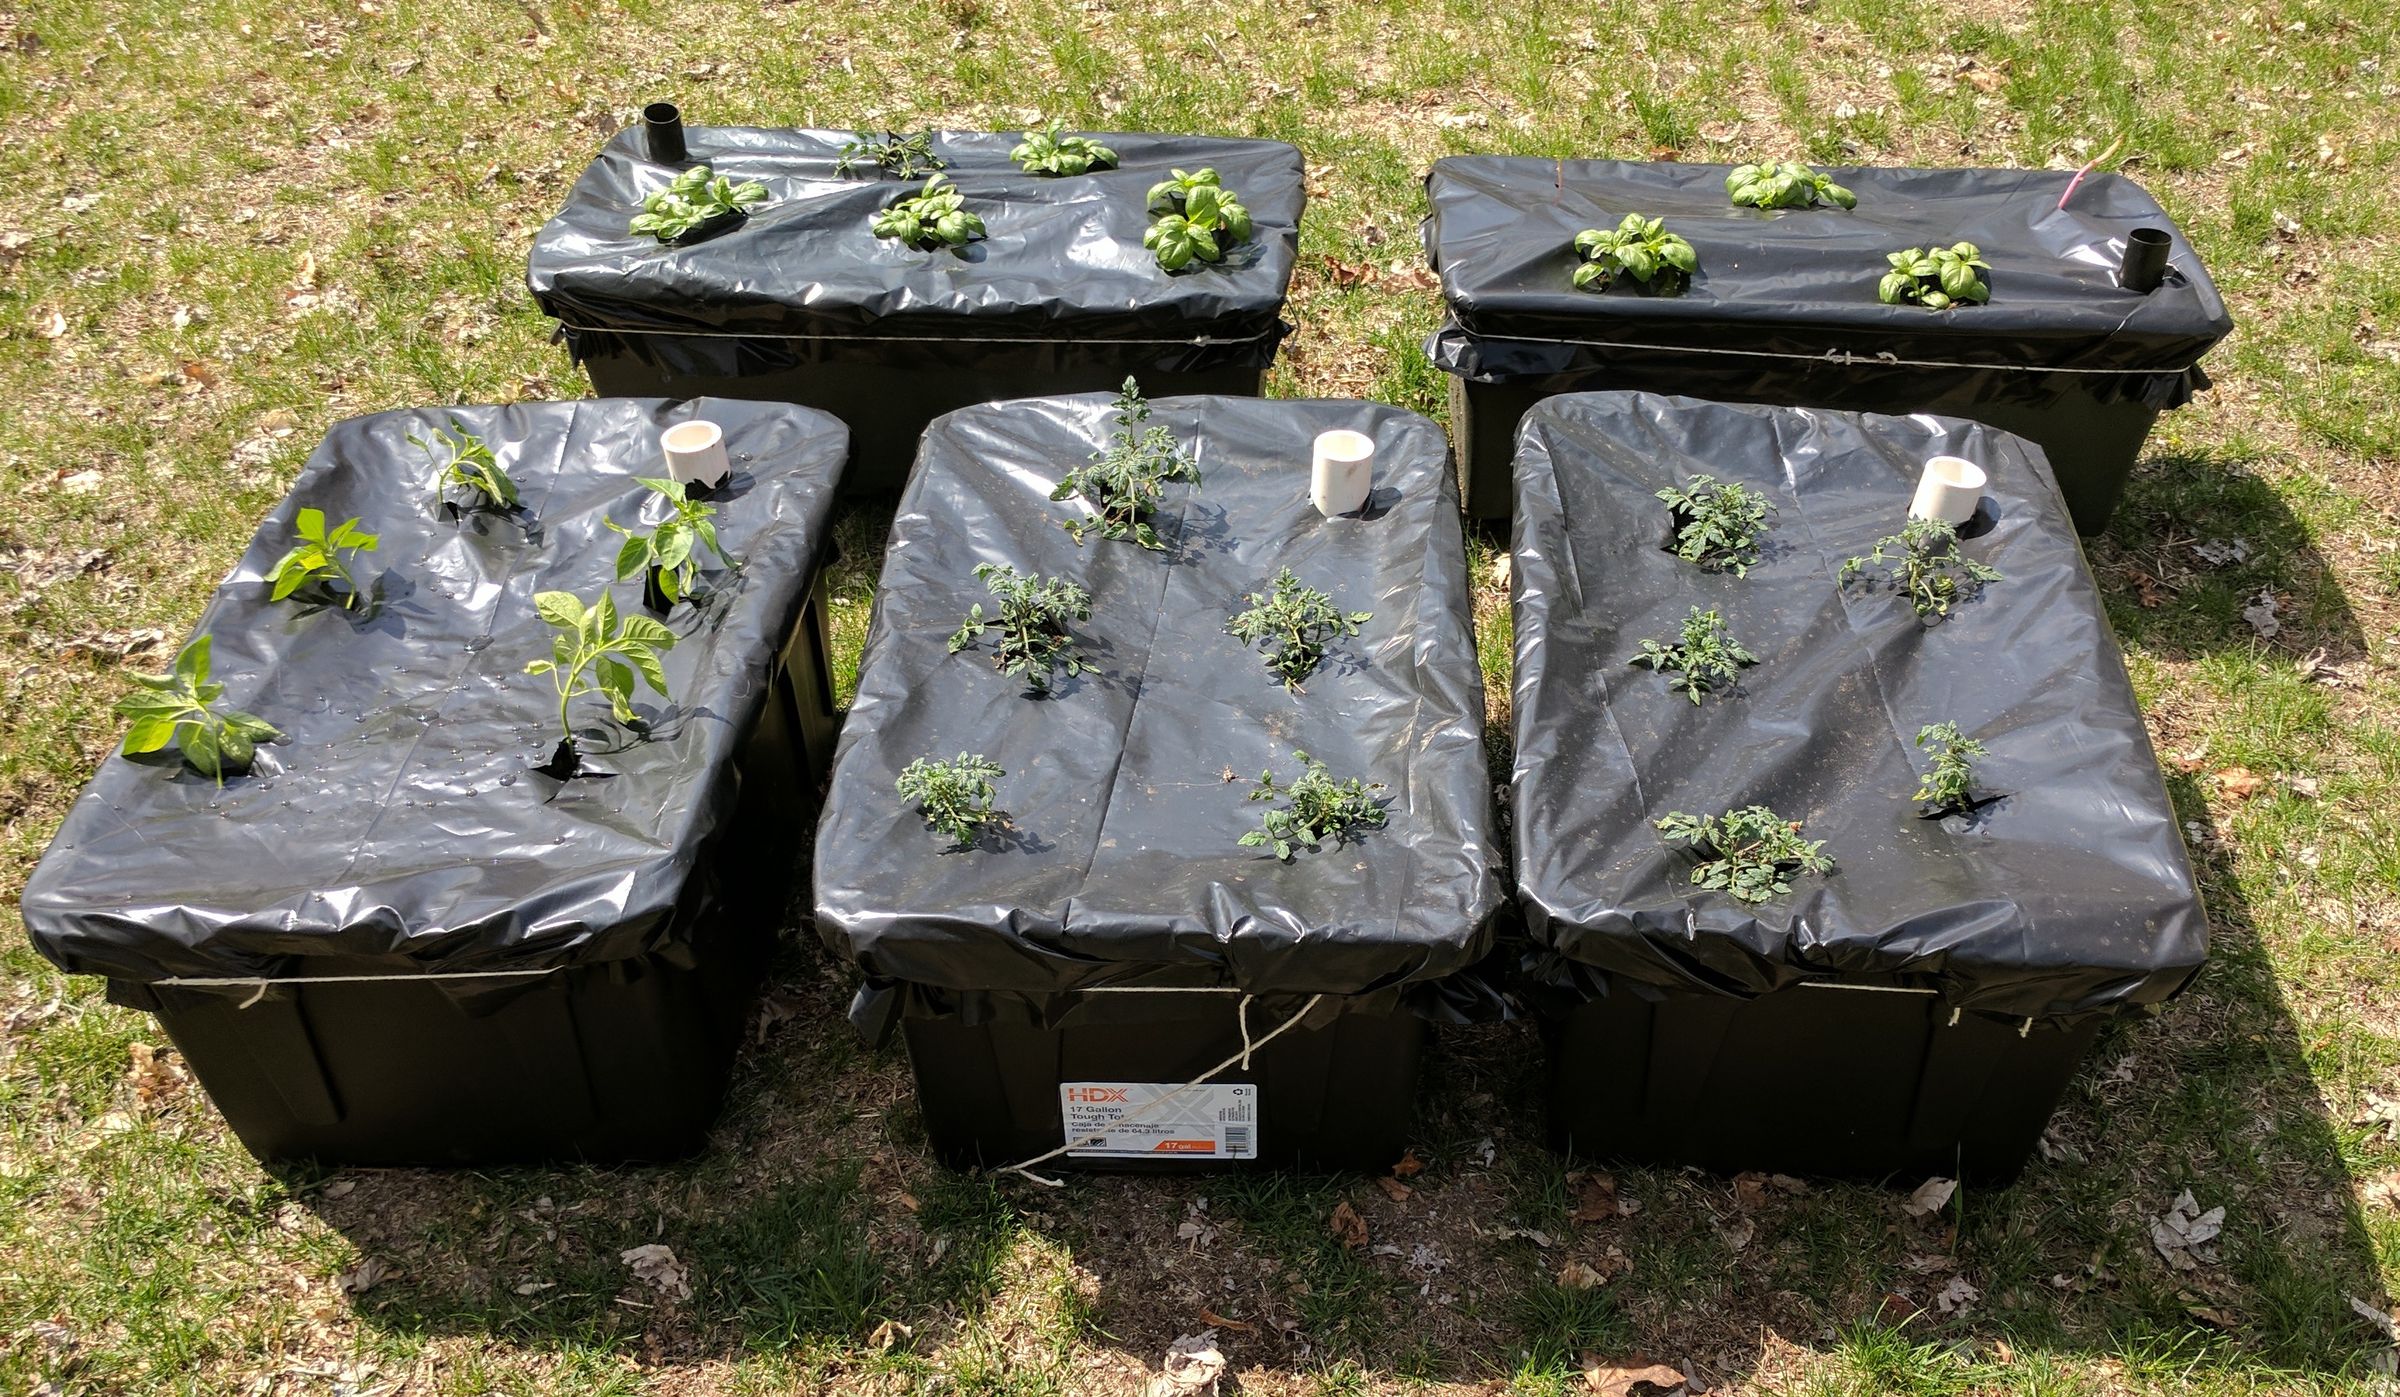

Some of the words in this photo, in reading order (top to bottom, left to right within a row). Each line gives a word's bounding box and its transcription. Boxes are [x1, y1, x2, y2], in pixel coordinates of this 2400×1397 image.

[1068, 1088, 1128, 1102] HDX
[1071, 1113, 1105, 1121] Tough
[1071, 1121, 1092, 1129] Caja
